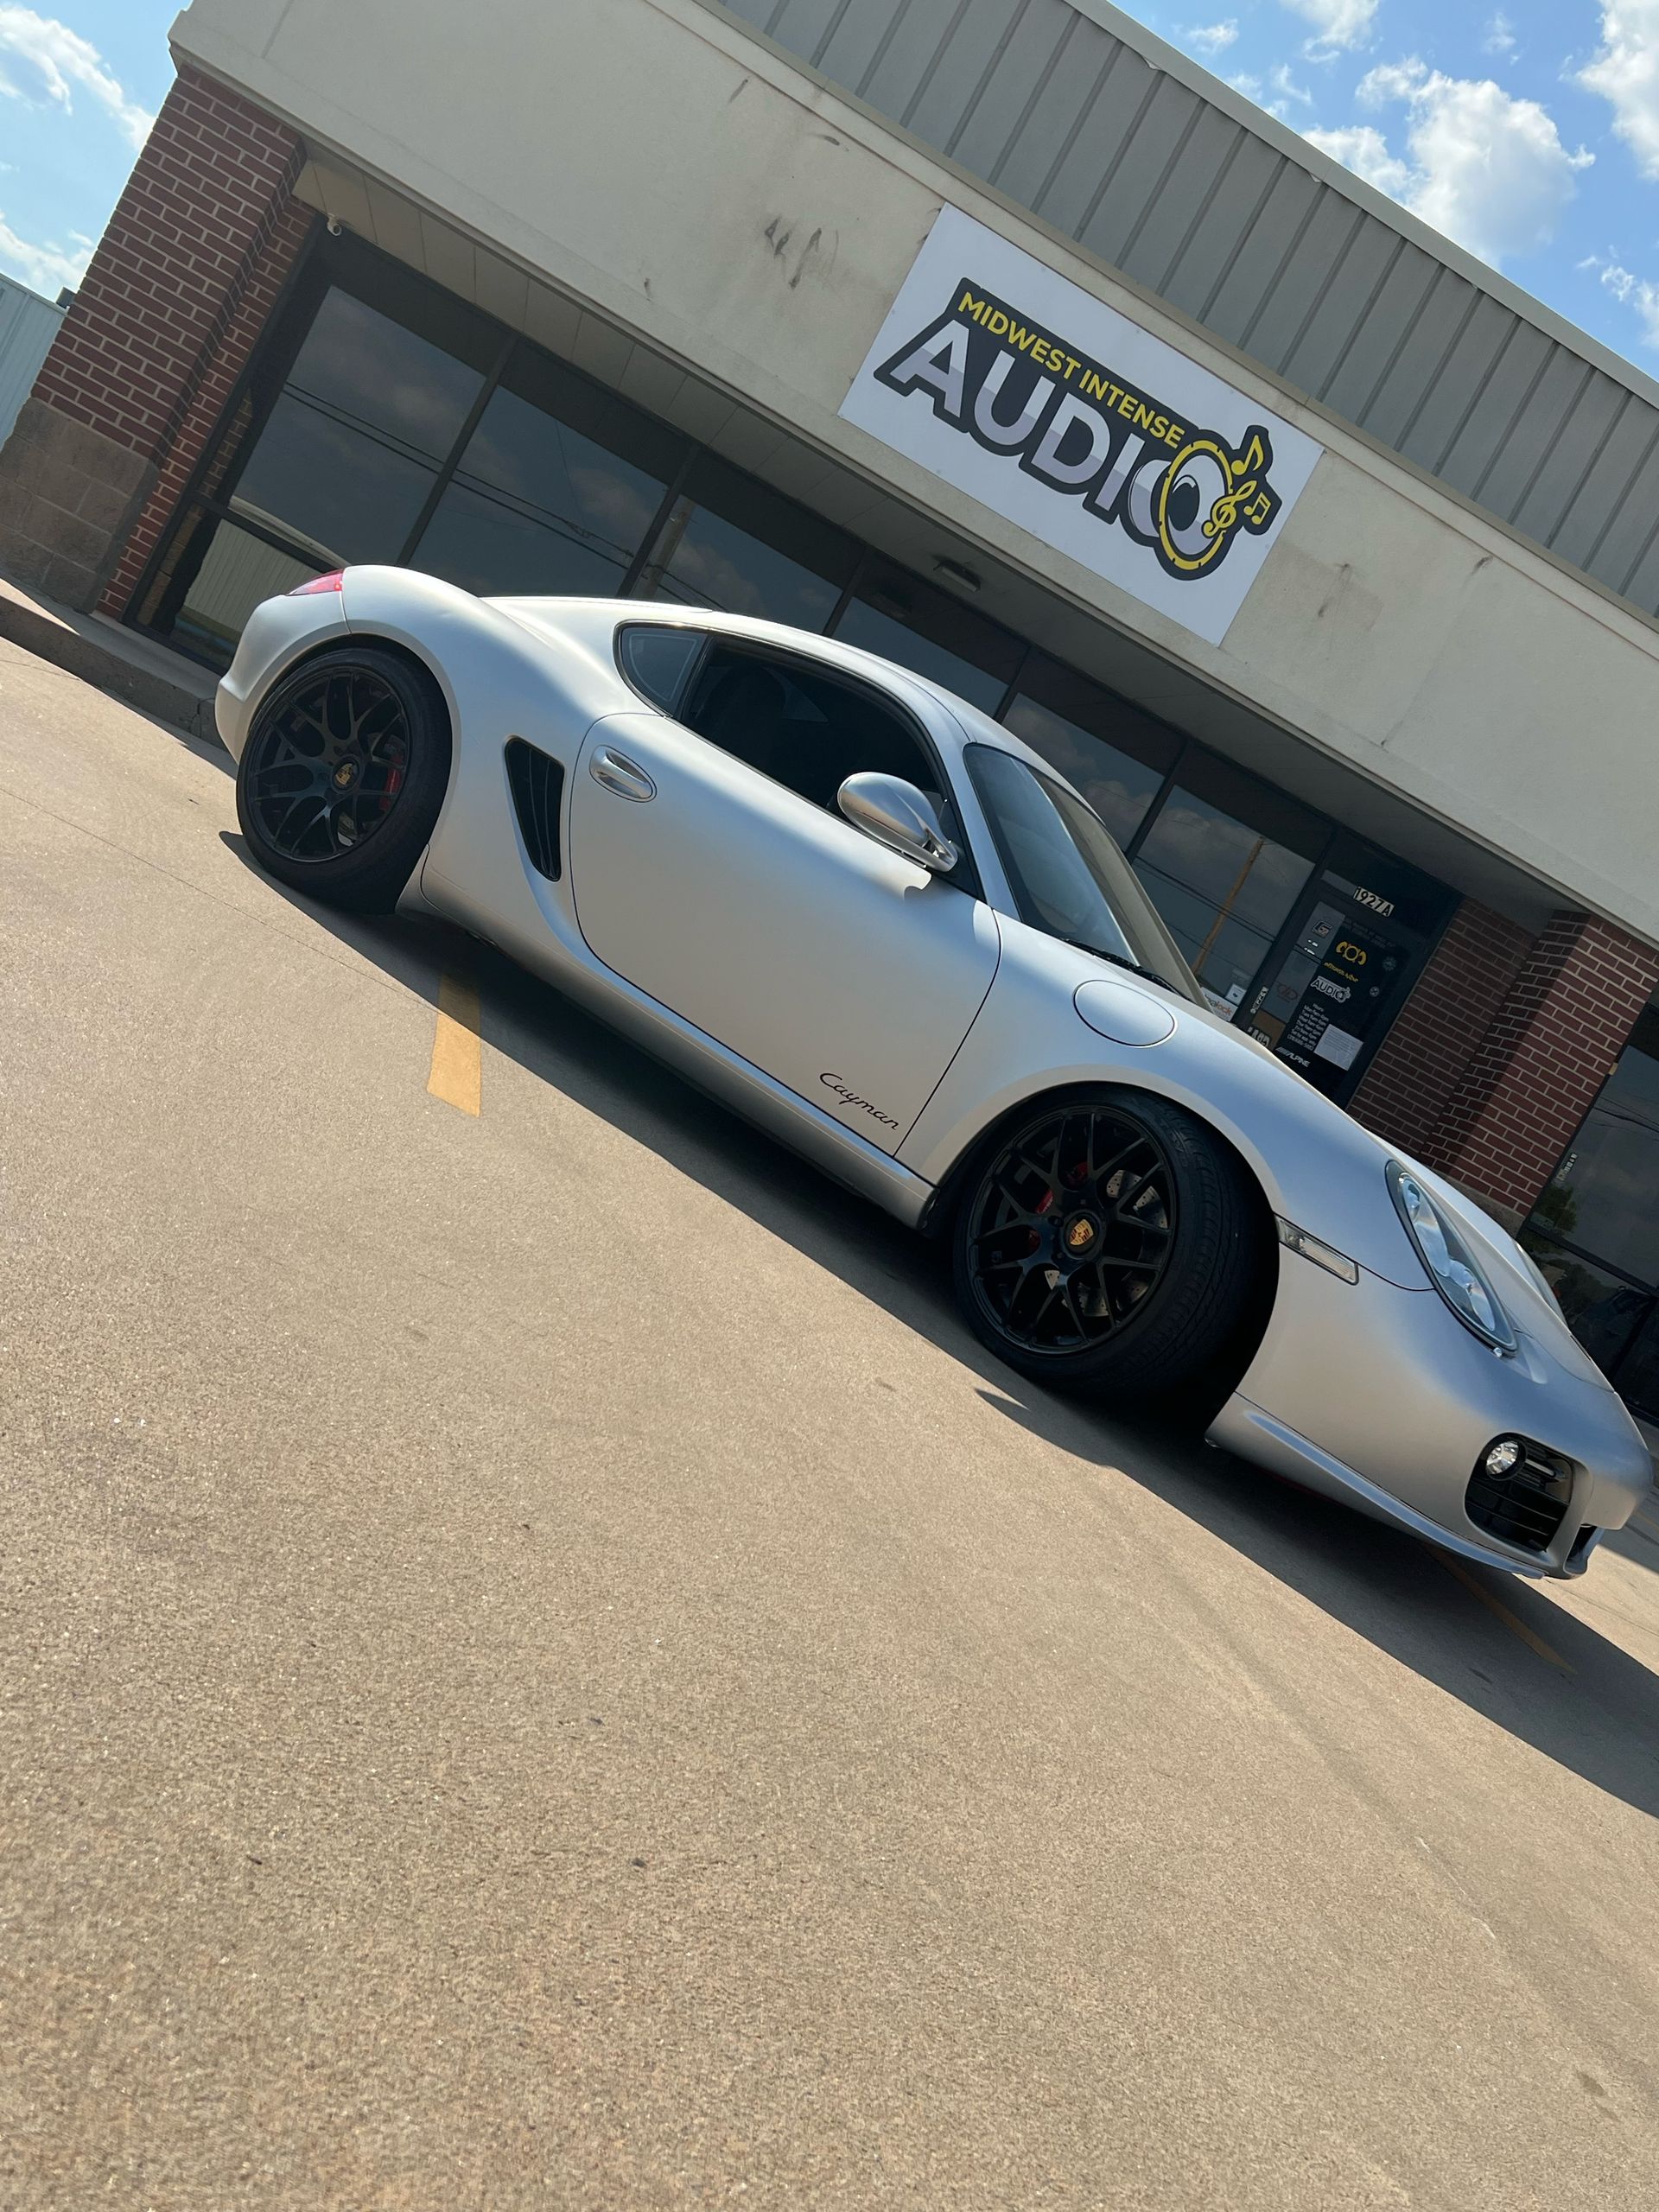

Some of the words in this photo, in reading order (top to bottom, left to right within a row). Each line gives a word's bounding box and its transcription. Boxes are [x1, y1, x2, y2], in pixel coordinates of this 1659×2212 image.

[957, 291, 1081, 380] MIDWEST
[1079, 369, 1185, 450] INTENSE
[889, 319, 1233, 570] AUDIO
[1354, 887, 1392, 916] 1927A
[1311, 979, 1346, 1002] AUDIO
[1283, 1048, 1311, 1068] ALPINE
[819, 1072, 899, 1131] Cayman
